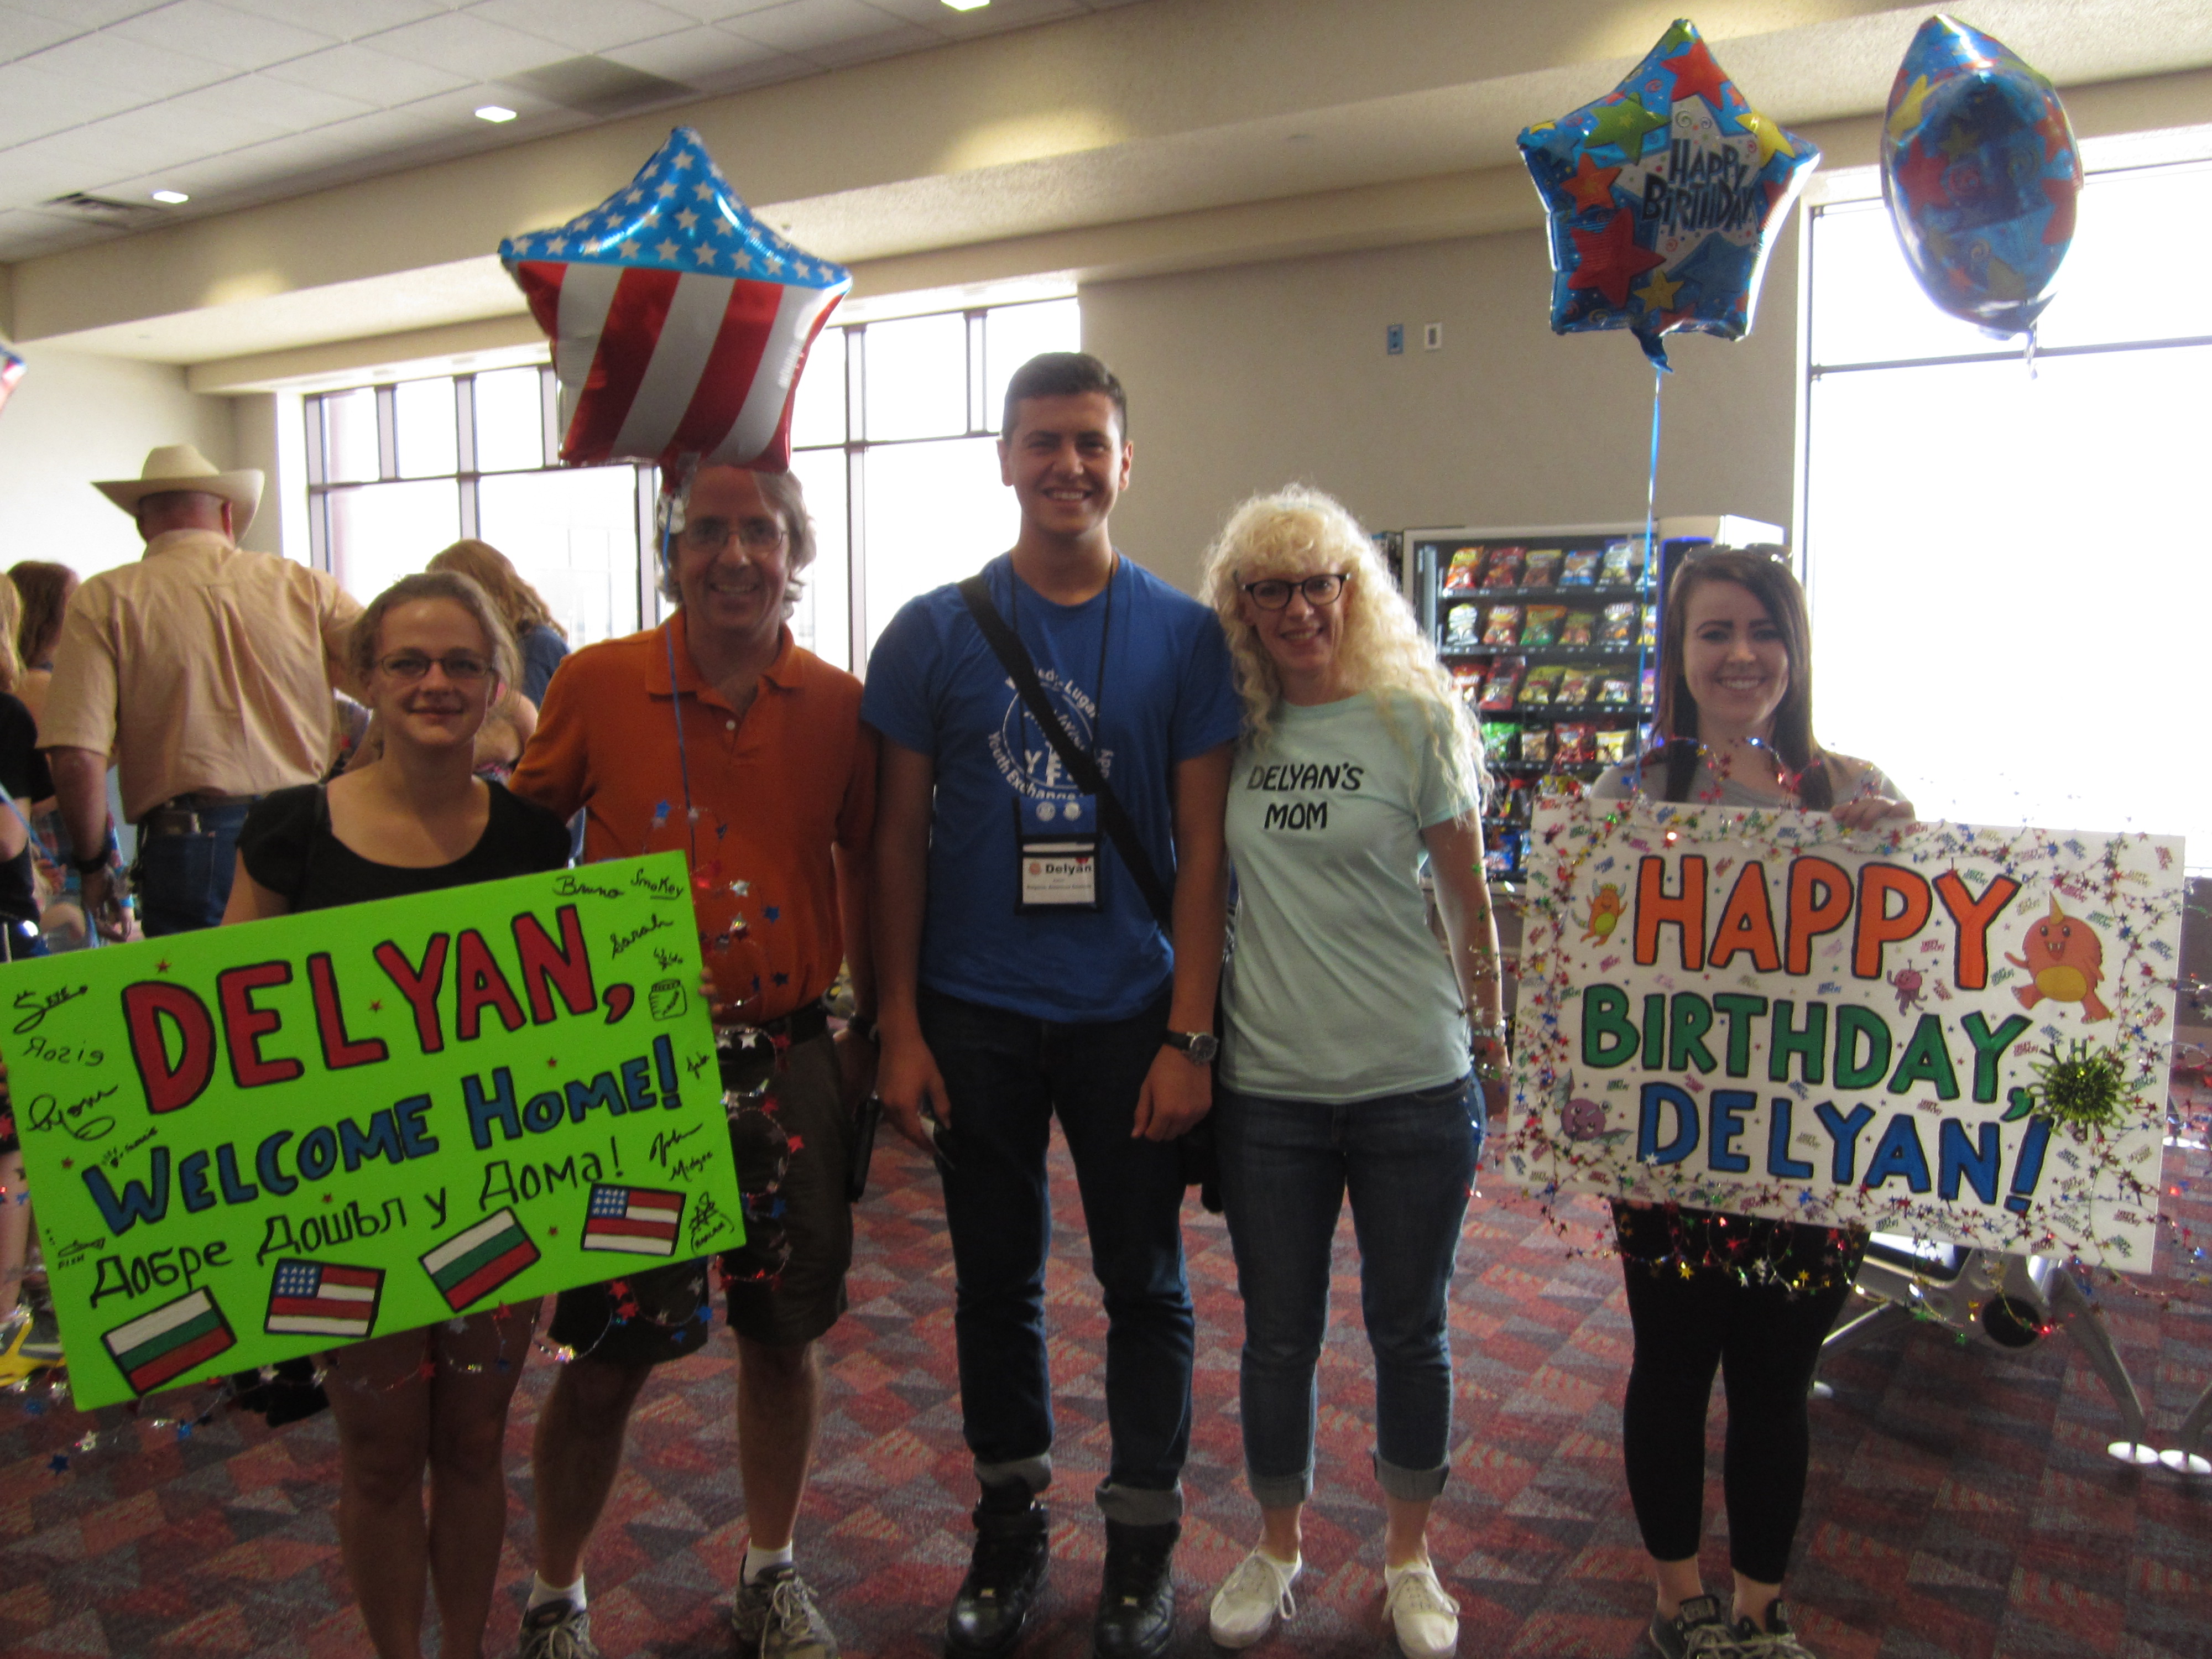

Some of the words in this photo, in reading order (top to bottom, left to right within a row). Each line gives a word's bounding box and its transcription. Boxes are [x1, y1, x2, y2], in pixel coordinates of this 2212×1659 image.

[1246, 761, 1364, 791] DELYAN'S
[1264, 801, 1327, 830] MOM
[1633, 854, 2022, 990] HAPPY
[122, 904, 635, 1114] DELYAN,
[1581, 983, 2036, 1121] BIRTHDAY,
[82, 1094, 439, 1237] WELCOME
[1636, 1081, 2056, 1213] DELYAN!
[90, 1240, 234, 1308] Добре
[479, 1135, 624, 1211] Дома!
